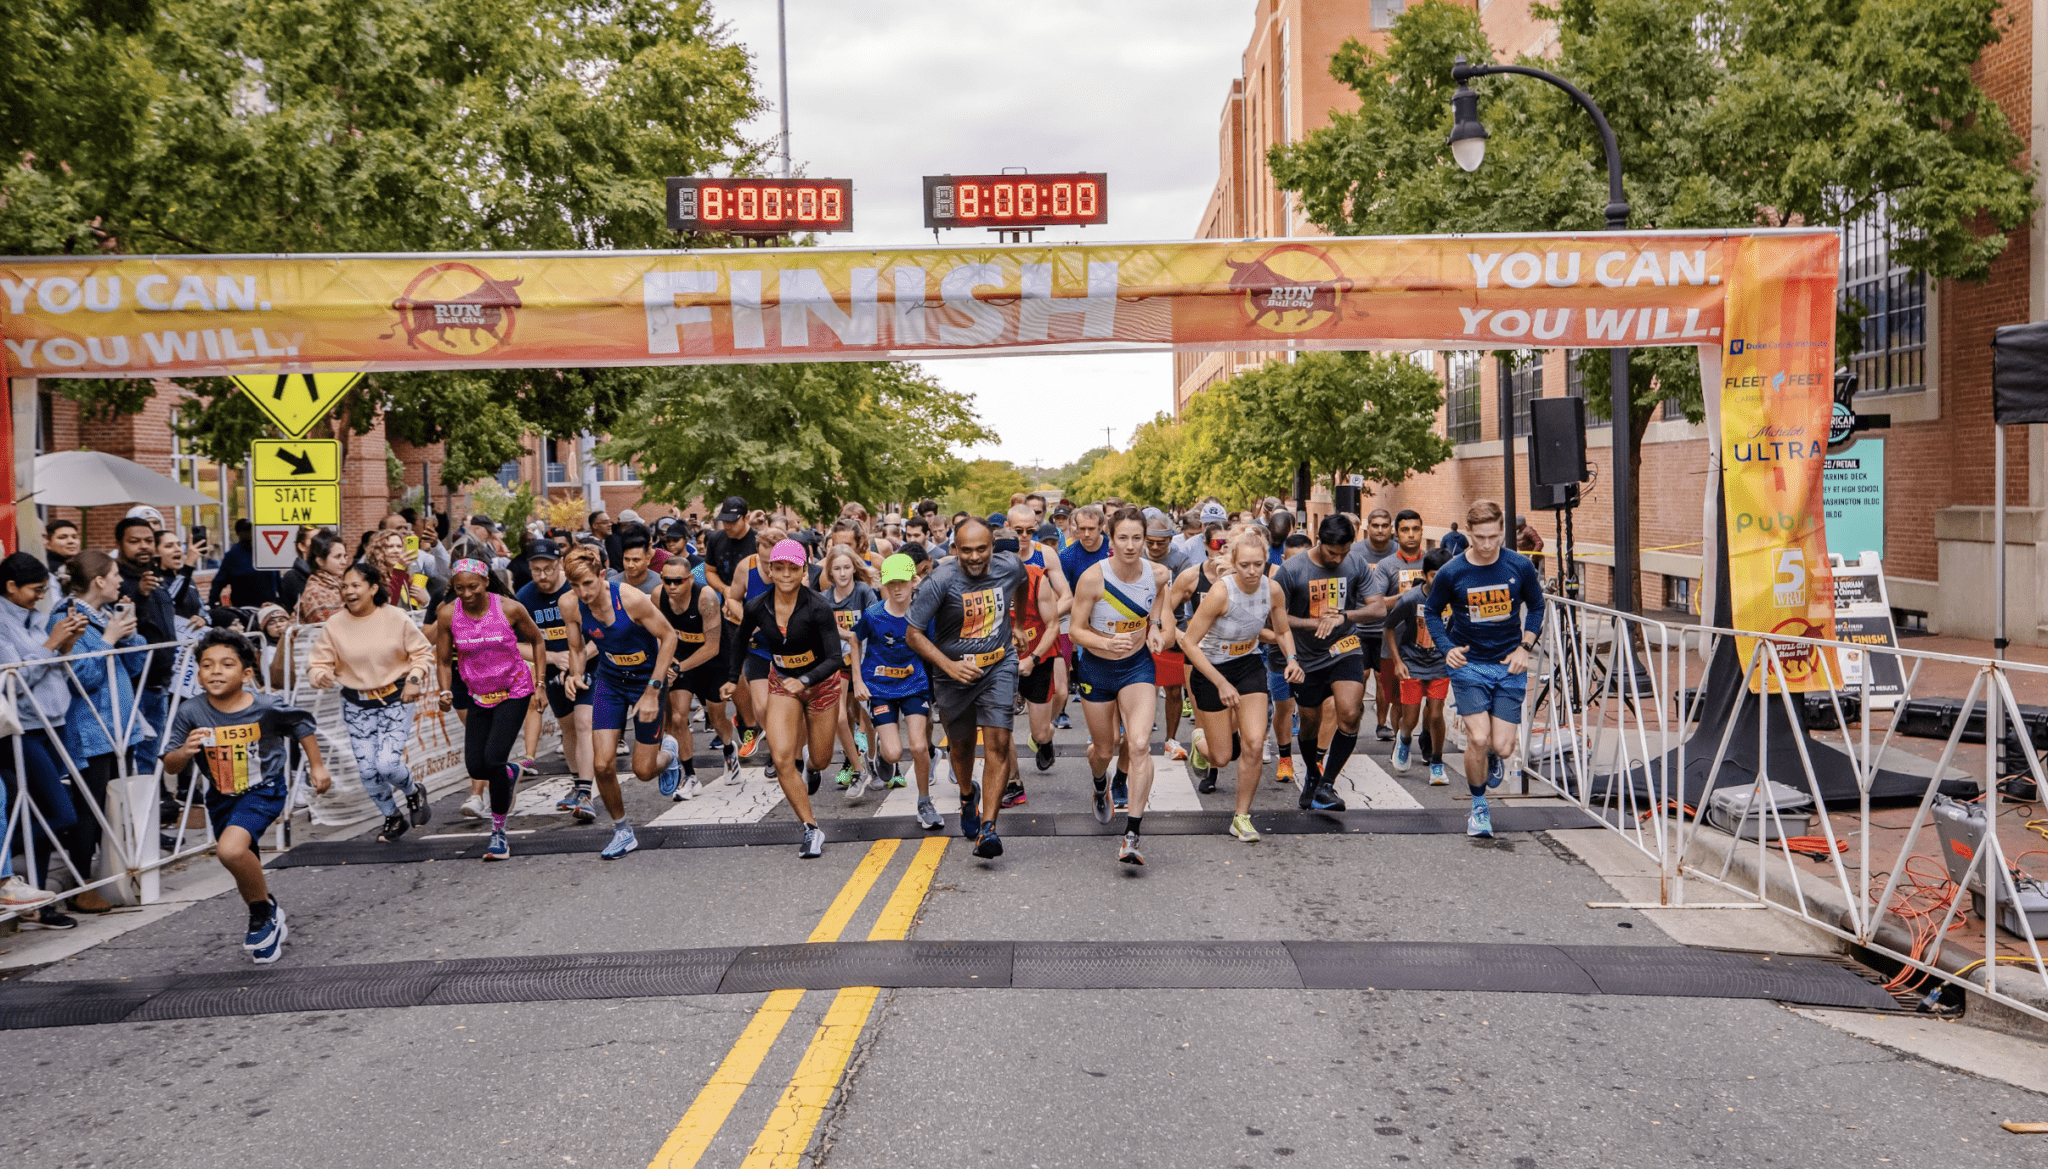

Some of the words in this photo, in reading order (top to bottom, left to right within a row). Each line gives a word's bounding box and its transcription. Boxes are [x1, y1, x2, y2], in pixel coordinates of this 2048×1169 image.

[1466, 251, 1581, 289] YOU
[1595, 250, 1720, 287] CAN.
[0, 274, 121, 315] YOU
[135, 274, 272, 311] CAN.
[1268, 286, 1316, 300] RUN
[643, 260, 1120, 354] FINISH
[1267, 299, 1289, 307] Bull
[1291, 300, 1314, 308] City
[434, 304, 482, 317] RUN
[436, 316, 460, 324] Bull
[461, 316, 485, 325] City
[1458, 307, 1570, 340] YOU
[1585, 307, 1722, 341] WILL.
[4, 335, 130, 369] YOU
[142, 327, 299, 363] WILL.
[1746, 342, 1767, 350] Duke
[1725, 376, 1768, 389] FLEET
[1788, 373, 1824, 386] FEET
[1831, 415, 1855, 425] RICAN
[1747, 424, 1804, 440] Michelob
[1734, 440, 1821, 462] ULTRA
[275, 488, 317, 502] STATE
[1857, 485, 1879, 493] SCHOOL
[281, 507, 312, 521] LAW
[1773, 551, 1805, 594] 5
[1311, 583, 1346, 593] BULL
[1839, 580, 1864, 589] DURHAM
[1311, 591, 1346, 602] CITY
[1467, 588, 1510, 606] RUN
[1775, 589, 1804, 606] WRAL
[1839, 588, 1862, 596] Chinese
[965, 593, 1003, 608] BULL
[966, 603, 1003, 617] CITY
[1483, 603, 1508, 614] 1250
[1122, 621, 1142, 630] 786
[1340, 637, 1359, 649] 1305
[1851, 634, 1888, 644] FINISH!
[788, 655, 808, 664] 486
[982, 651, 1000, 662] 941
[1875, 684, 1898, 692] RESULTS
[223, 728, 253, 740] 1531
[208, 749, 257, 761] CITY
[426, 757, 446, 776] Race
[446, 749, 462, 768] Fest
